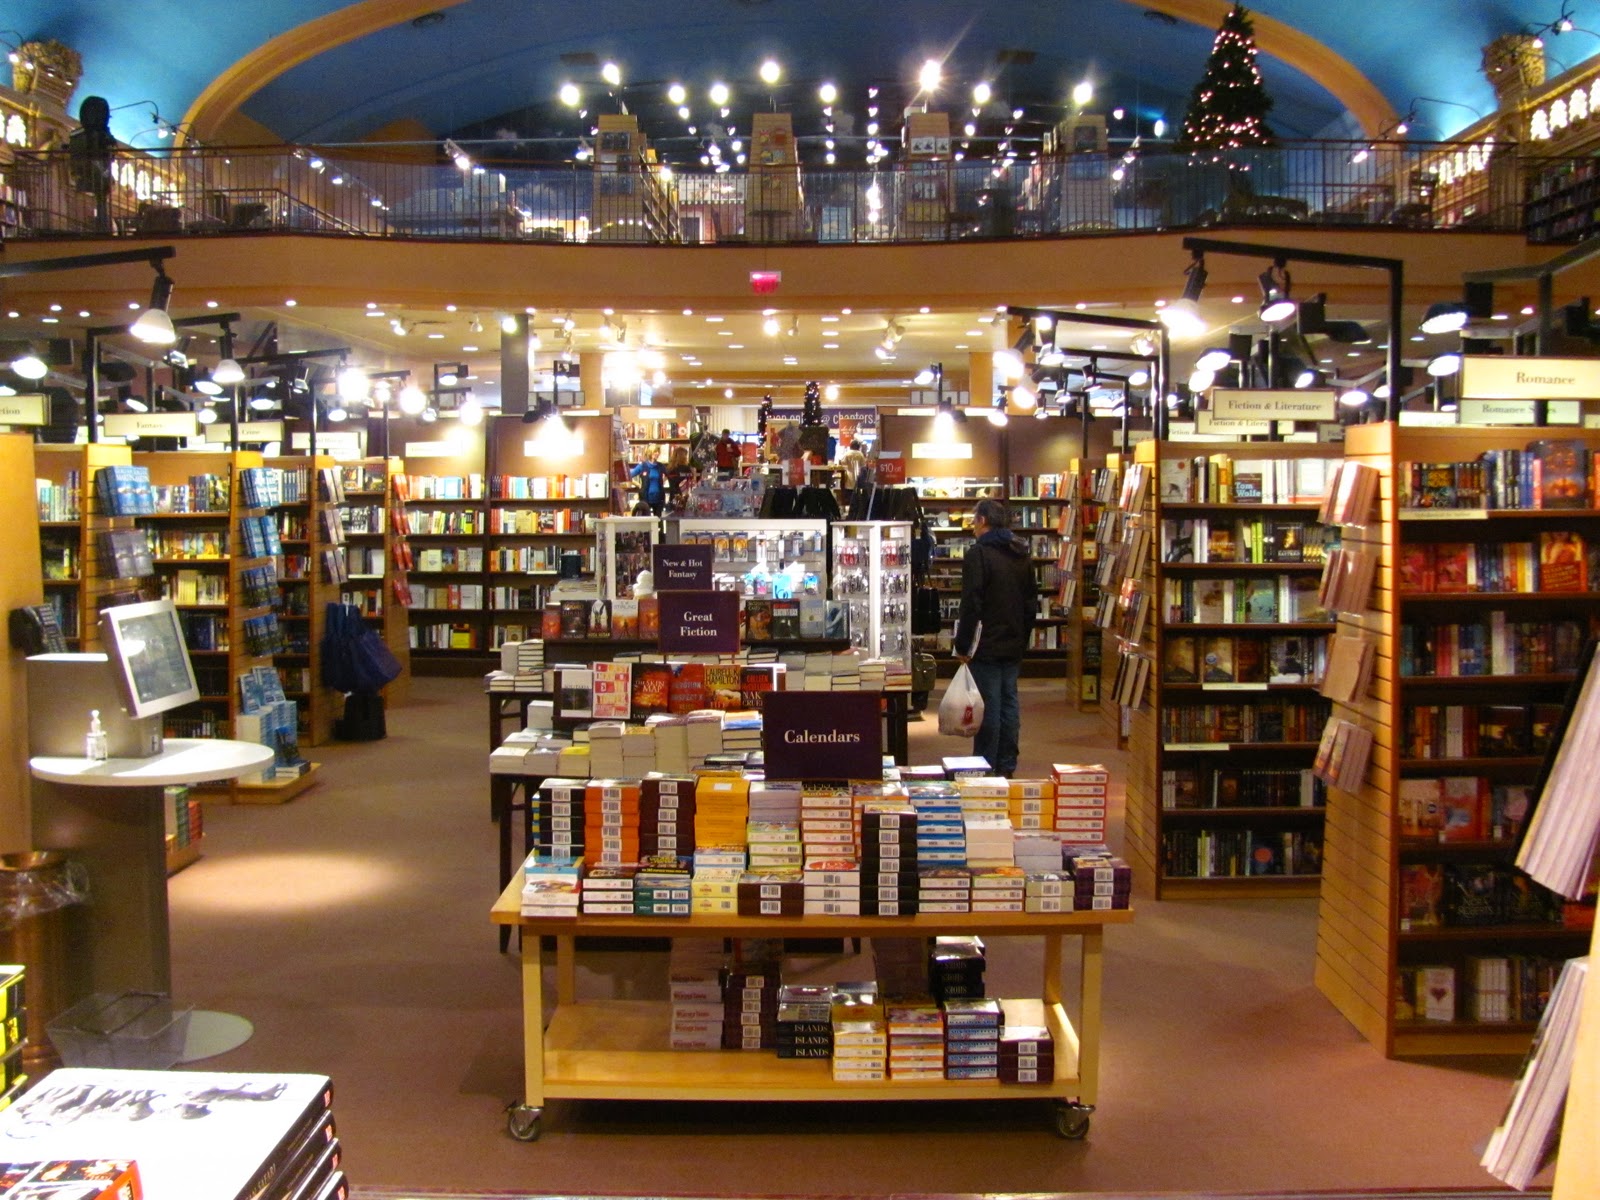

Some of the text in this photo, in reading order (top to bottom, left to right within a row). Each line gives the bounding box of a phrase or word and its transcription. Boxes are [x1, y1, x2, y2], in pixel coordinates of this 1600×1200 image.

[1516, 372, 1576, 385] Romance
[1228, 400, 1322, 411] Fiction & Literature
[1482, 404, 1525, 414] Romance
[1246, 419, 1284, 427] Literae
[880, 462, 894, 473] $10
[1235, 481, 1253, 490] Tom
[1237, 489, 1261, 497] Wolfe
[663, 559, 678, 567] New
[688, 559, 703, 567] Hot
[668, 570, 697, 580] Fantasy
[683, 611, 713, 622] Great
[680, 626, 717, 637] Fiction
[642, 685, 662, 693] MAP
[742, 691, 762, 700] NAK
[784, 728, 861, 744] Calendars
[794, 1024, 829, 1032] ISLANDS
[795, 1036, 830, 1044] ISLANDS
[795, 1048, 830, 1057] ISLANDS
